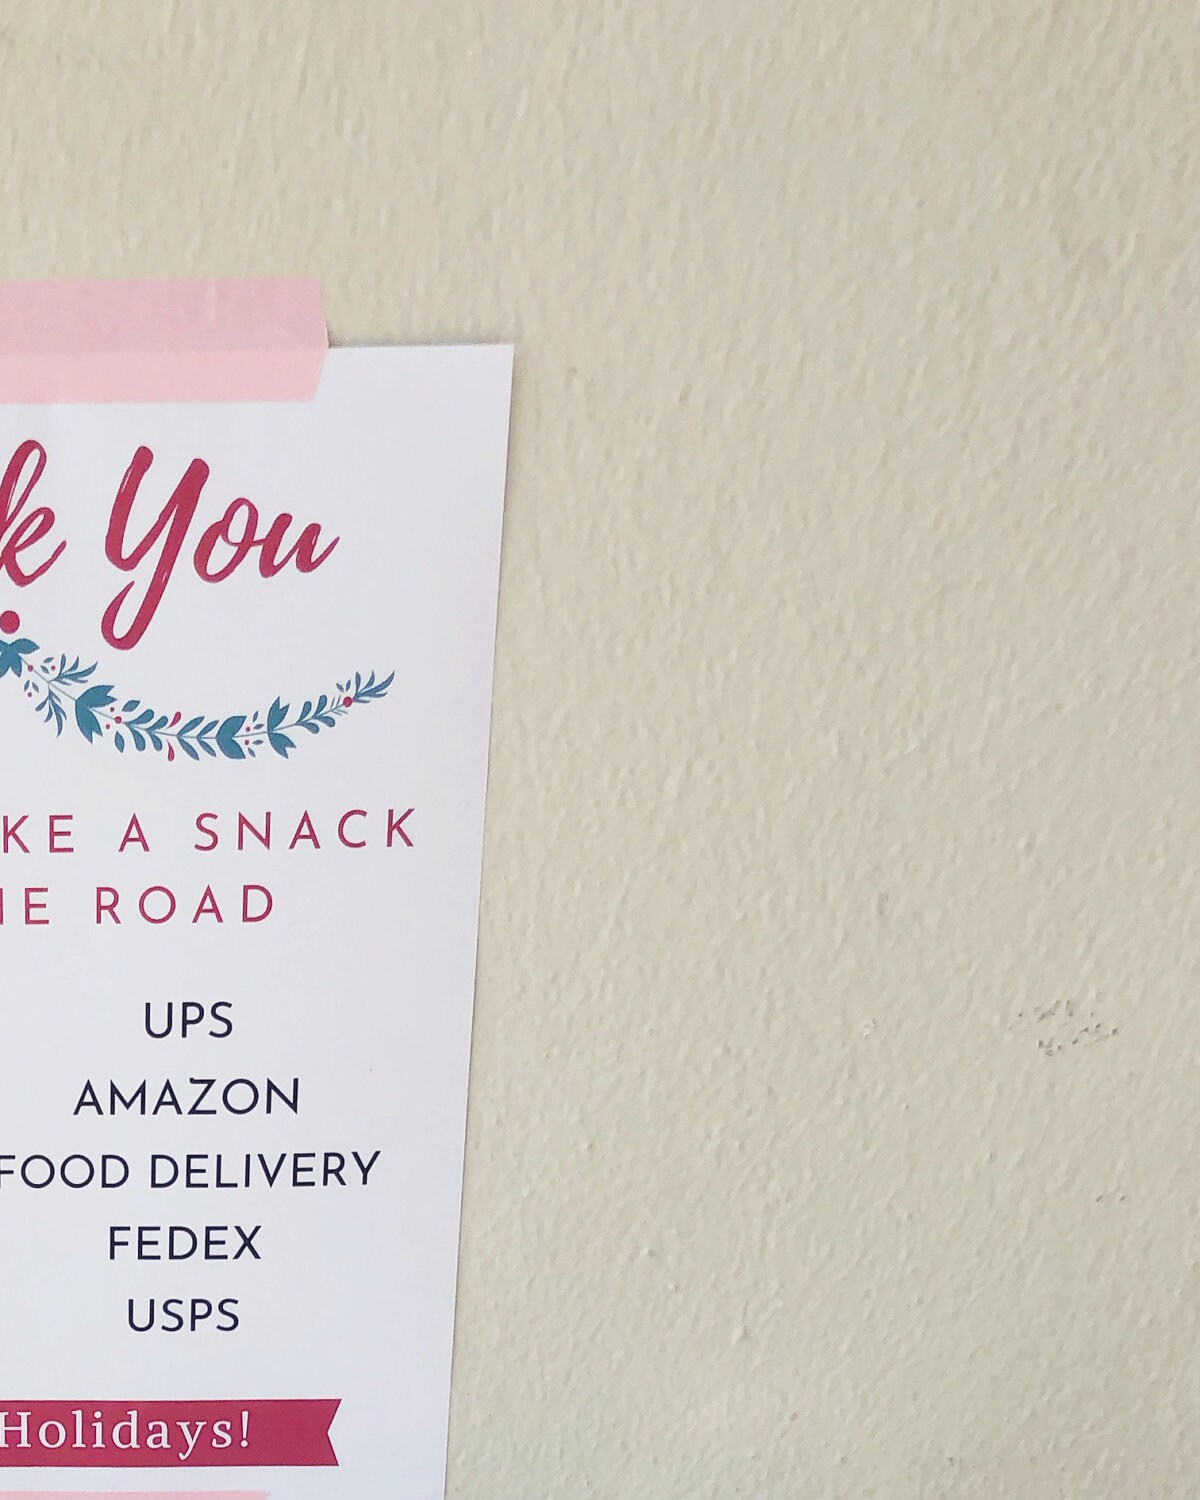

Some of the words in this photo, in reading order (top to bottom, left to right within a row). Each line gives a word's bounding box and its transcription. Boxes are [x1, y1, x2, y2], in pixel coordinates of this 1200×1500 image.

[101, 445, 339, 650] You
[119, 814, 150, 852] A
[195, 808, 418, 851] SNACK
[96, 884, 275, 924] ROAD
[145, 1001, 234, 1039] UPS
[73, 1077, 300, 1116] AMAZON
[150, 1150, 381, 1189] DELIVERY
[108, 1225, 262, 1261] FEDEX
[127, 1298, 240, 1333] USPS
